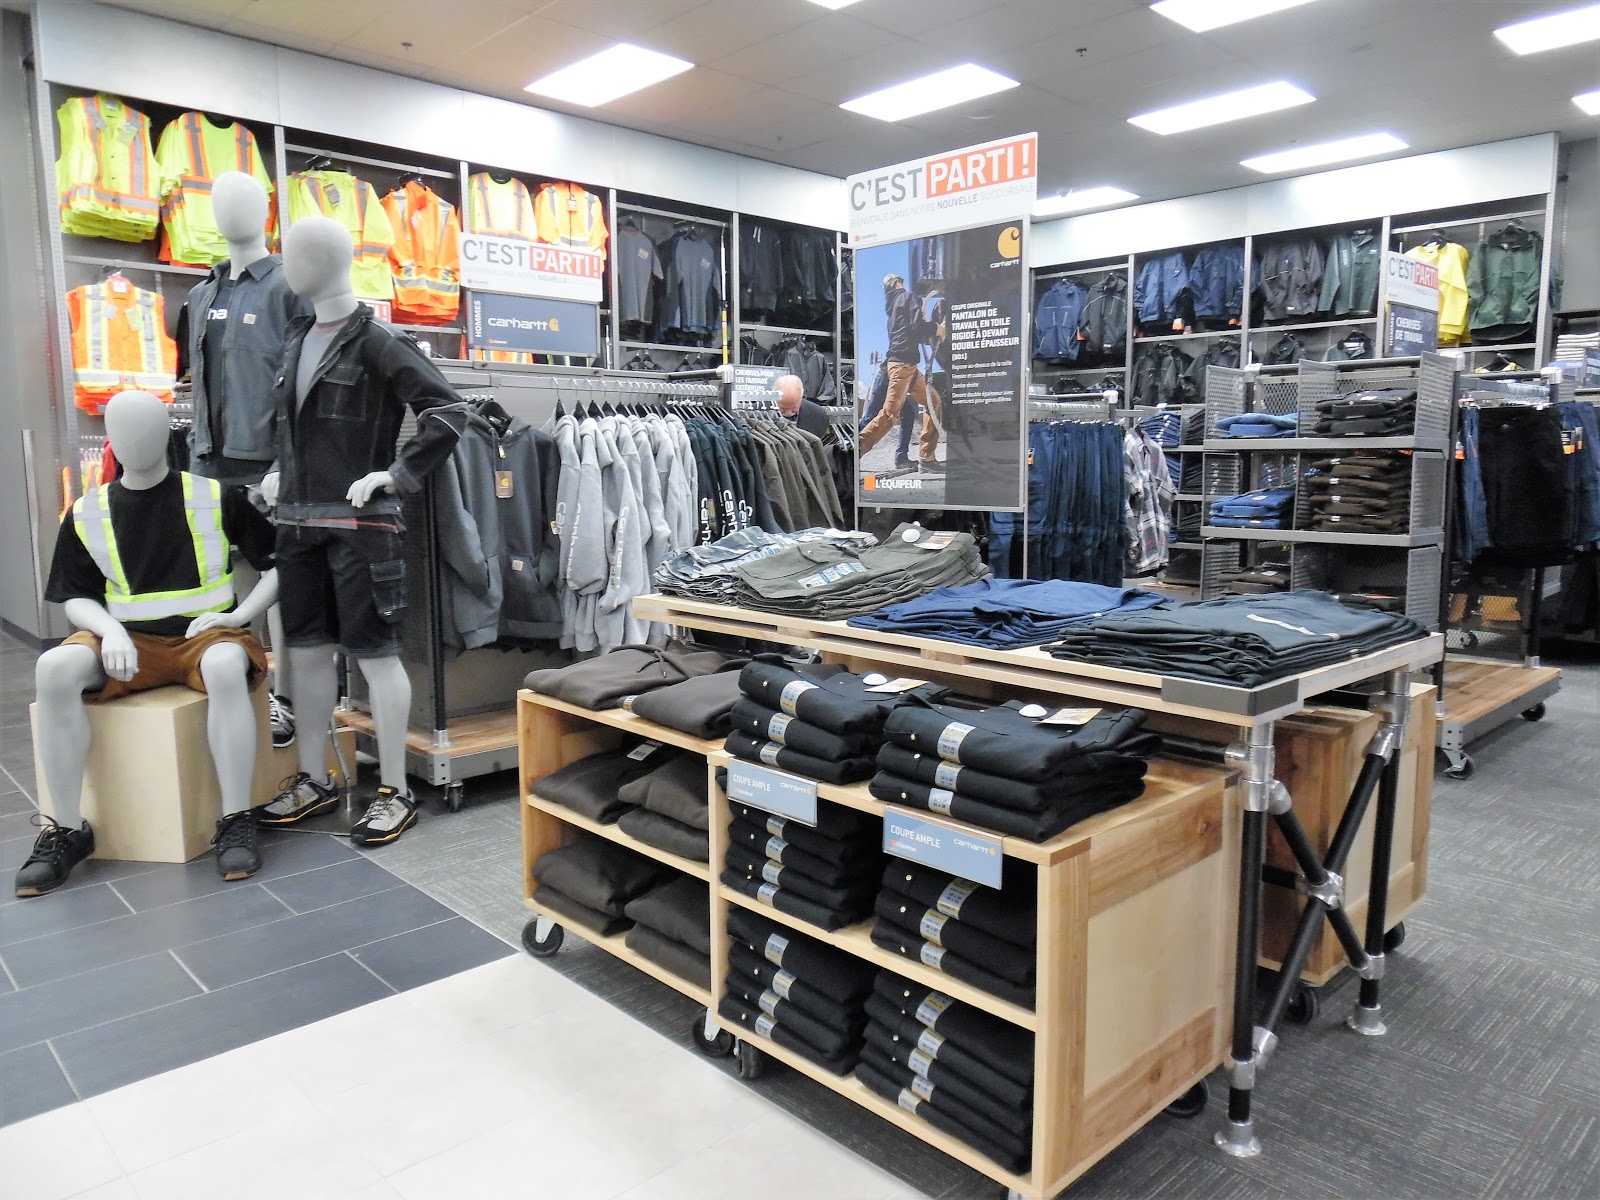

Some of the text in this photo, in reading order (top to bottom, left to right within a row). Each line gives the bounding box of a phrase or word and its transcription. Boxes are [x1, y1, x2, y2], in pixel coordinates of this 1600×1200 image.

[851, 167, 923, 211] C'EST
[937, 194, 978, 209] NOUVELLE
[980, 182, 1035, 201] SUCCURSALE
[463, 239, 527, 267] C'EST
[989, 259, 1020, 269] carhartt
[1389, 257, 1414, 280] C'EST
[967, 301, 992, 309] ORIGINALE
[474, 300, 482, 338] HOMMES
[951, 308, 998, 321] PANTALON DE
[487, 317, 549, 331] carhartt
[951, 317, 1011, 331] TRAVAIL EN TOILE
[951, 327, 1009, 341] RIGIDE À DEVANT
[951, 337, 1020, 351] DOUBLE ÉPAISSEUR
[876, 477, 922, 490] L'ÉQUIPEUR
[733, 774, 806, 794] COUPE AMPLE carhartt
[890, 825, 989, 854] COUPE AMPLE carhartt
